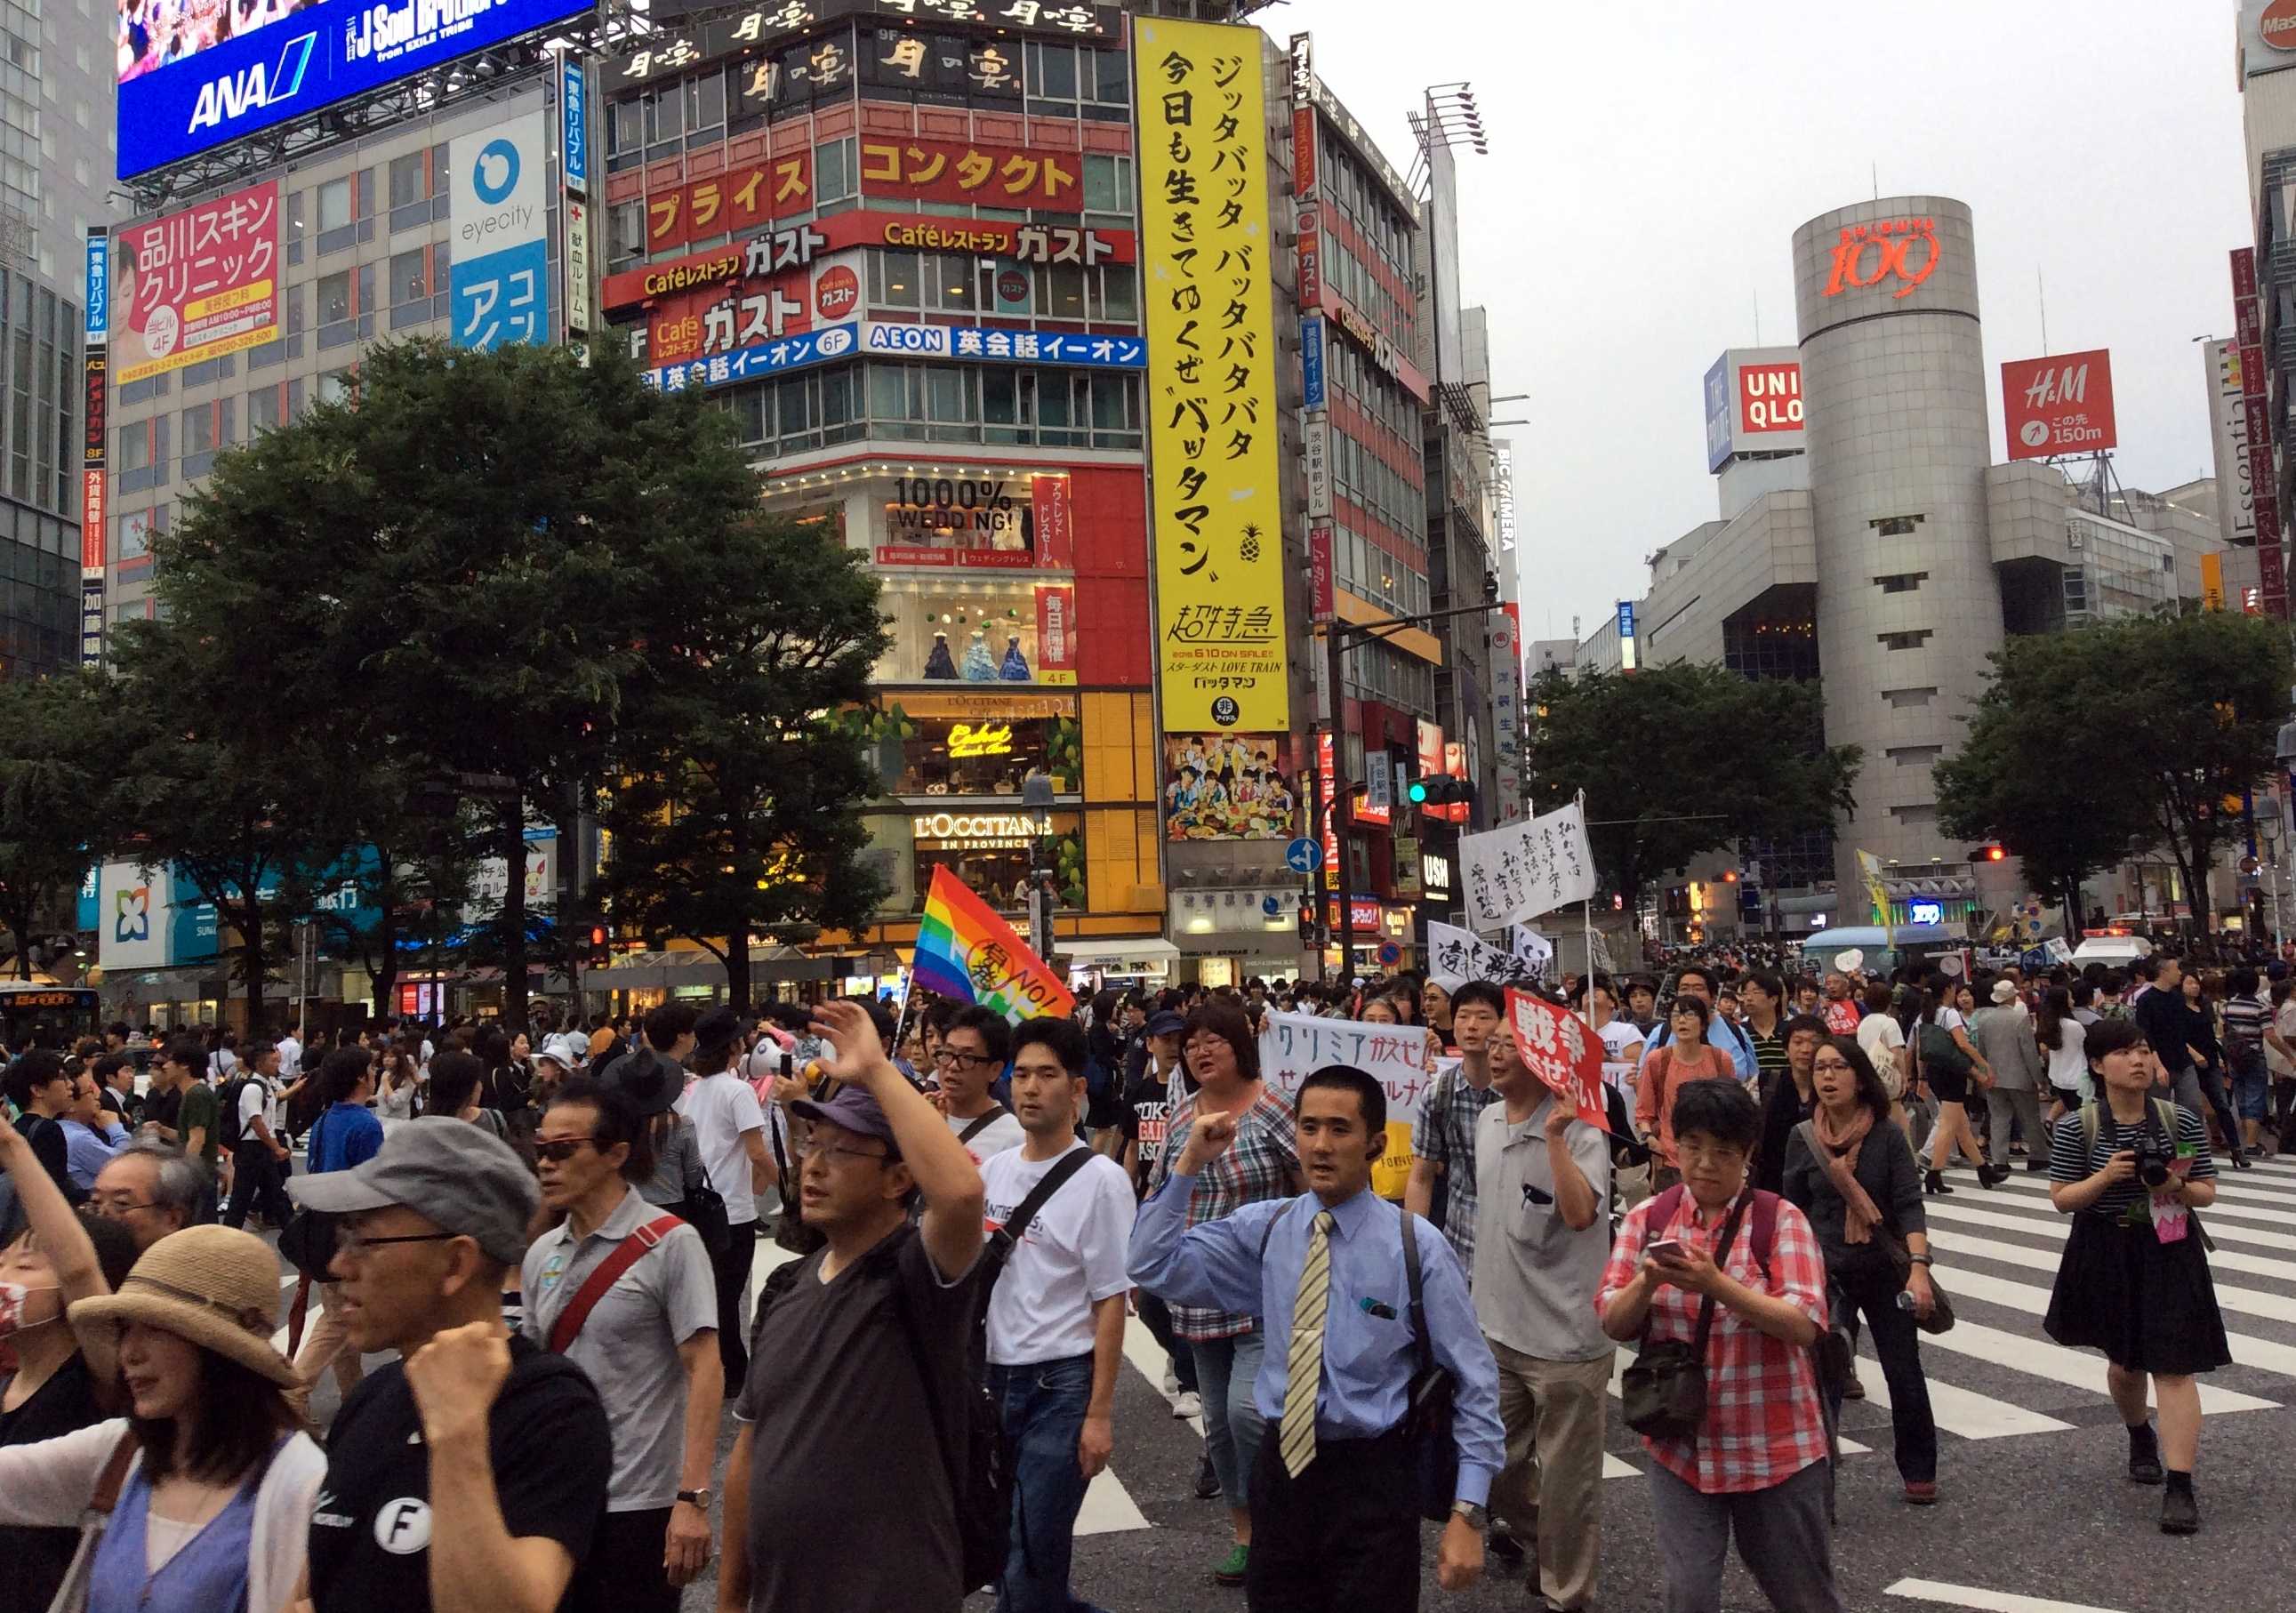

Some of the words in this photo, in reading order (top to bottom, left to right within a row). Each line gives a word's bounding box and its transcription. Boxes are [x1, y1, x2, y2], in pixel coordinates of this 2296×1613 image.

[377, 45, 403, 63] from
[405, 31, 437, 52] EXILE
[439, 18, 474, 38] TRIBE
[879, 28, 898, 41] 9F
[622, 39, 693, 77] 月の宴
[743, 44, 846, 101] 月の宴
[880, 39, 1011, 88] 月の宴
[188, 61, 266, 134] ANA
[863, 144, 1074, 197] コンタクト
[650, 160, 808, 238] プライス
[140, 197, 274, 272] 品川スキン
[462, 205, 534, 244] eyecity
[884, 221, 1008, 252] Caféレストラン
[1017, 226, 1112, 266] ガスト
[140, 237, 273, 312] クリニック
[571, 233, 583, 313] 献血ルーム
[644, 255, 739, 295] Caféレストラン
[746, 226, 823, 277] ガスト
[1821, 232, 1940, 299] 109
[90, 253, 103, 327] 東急リバブル
[822, 288, 855, 308] ガスト
[149, 314, 175, 335] 当ビル
[657, 316, 698, 343] Café
[704, 291, 801, 354] ガスト
[870, 325, 943, 350] AEON
[152, 334, 170, 351] 4F
[823, 337, 843, 351] 6F
[958, 329, 1140, 363] 英会話イーオン
[1748, 372, 1797, 397] UNI
[2025, 364, 2087, 408] H&M
[1750, 399, 1803, 428] QLO
[2052, 413, 2088, 427] この先
[2054, 427, 2101, 444] 150m
[1310, 431, 1324, 510] 渋谷駅前ビル
[1497, 448, 1511, 477] BIC
[894, 477, 1012, 510] 1000%
[896, 510, 1013, 531] WEDDING!
[1045, 594, 1064, 663] 毎日開催
[1168, 605, 1278, 644] 超特急
[1167, 662, 1218, 672] スターダスト
[1221, 662, 1247, 673] LOVE
[1250, 662, 1282, 673] TRAIN
[1221, 650, 1237, 659] ON
[1048, 673, 1067, 684] 4F
[1194, 676, 1256, 691] バッタマン
[1219, 699, 1232, 713] 非
[942, 839, 959, 849] EN
[963, 839, 1029, 849] PROVENCE
[1013, 968, 1058, 1013] NO!
[1515, 997, 1586, 1064] 戦争
[389, 1504, 421, 1545] F
